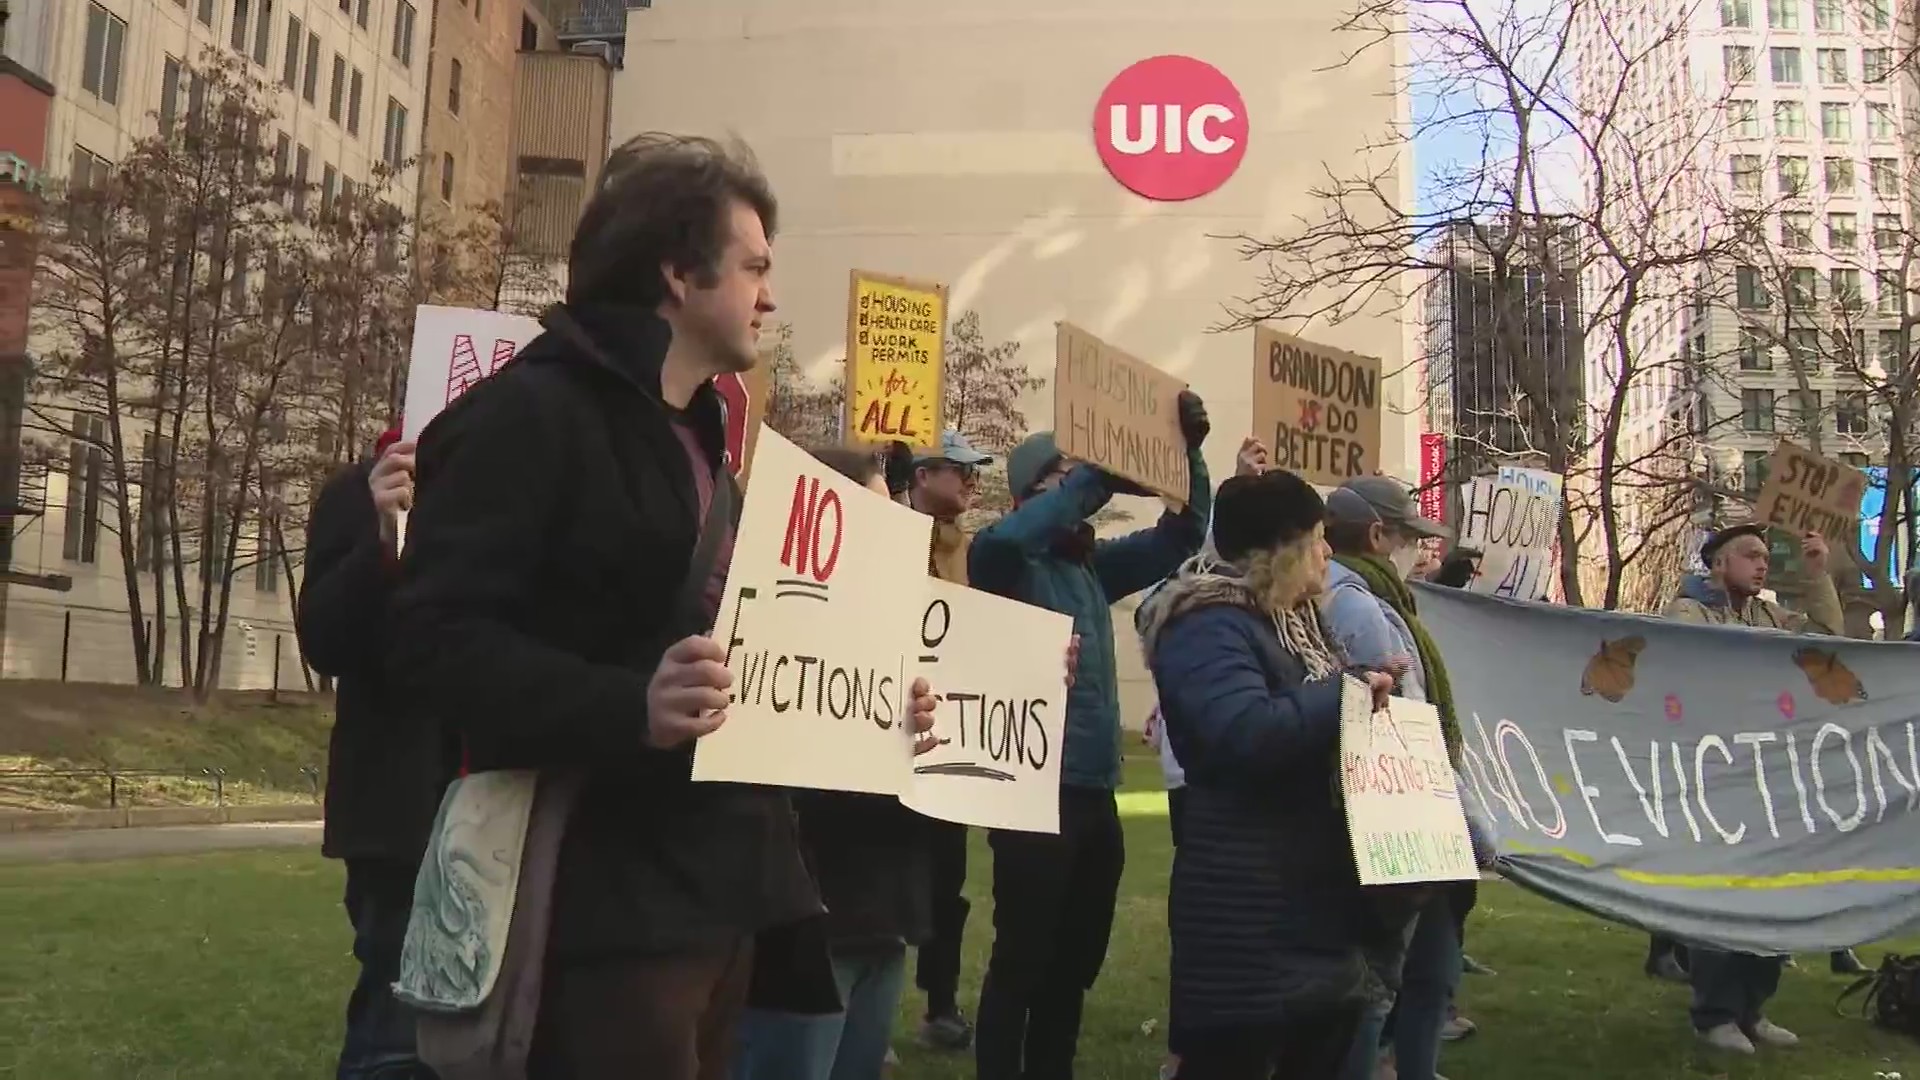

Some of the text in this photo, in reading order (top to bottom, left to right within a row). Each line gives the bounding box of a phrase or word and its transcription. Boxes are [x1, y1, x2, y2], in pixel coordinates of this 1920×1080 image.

[1109, 103, 1236, 155] UIC
[872, 291, 932, 318] HOUSING
[871, 347, 929, 364] PERMITS
[872, 334, 917, 349] WORK
[884, 367, 909, 398] for
[1068, 334, 1159, 416] HOUSING
[1269, 340, 1376, 409] BRANDON
[860, 399, 918, 437] ALL
[1070, 401, 1150, 477] HUMAN
[1327, 403, 1358, 434] DO
[1274, 421, 1364, 477] BETTER
[1779, 455, 1840, 500] STOP
[780, 474, 843, 582] NO
[922, 599, 951, 648] O
[1461, 711, 1568, 840] NO
